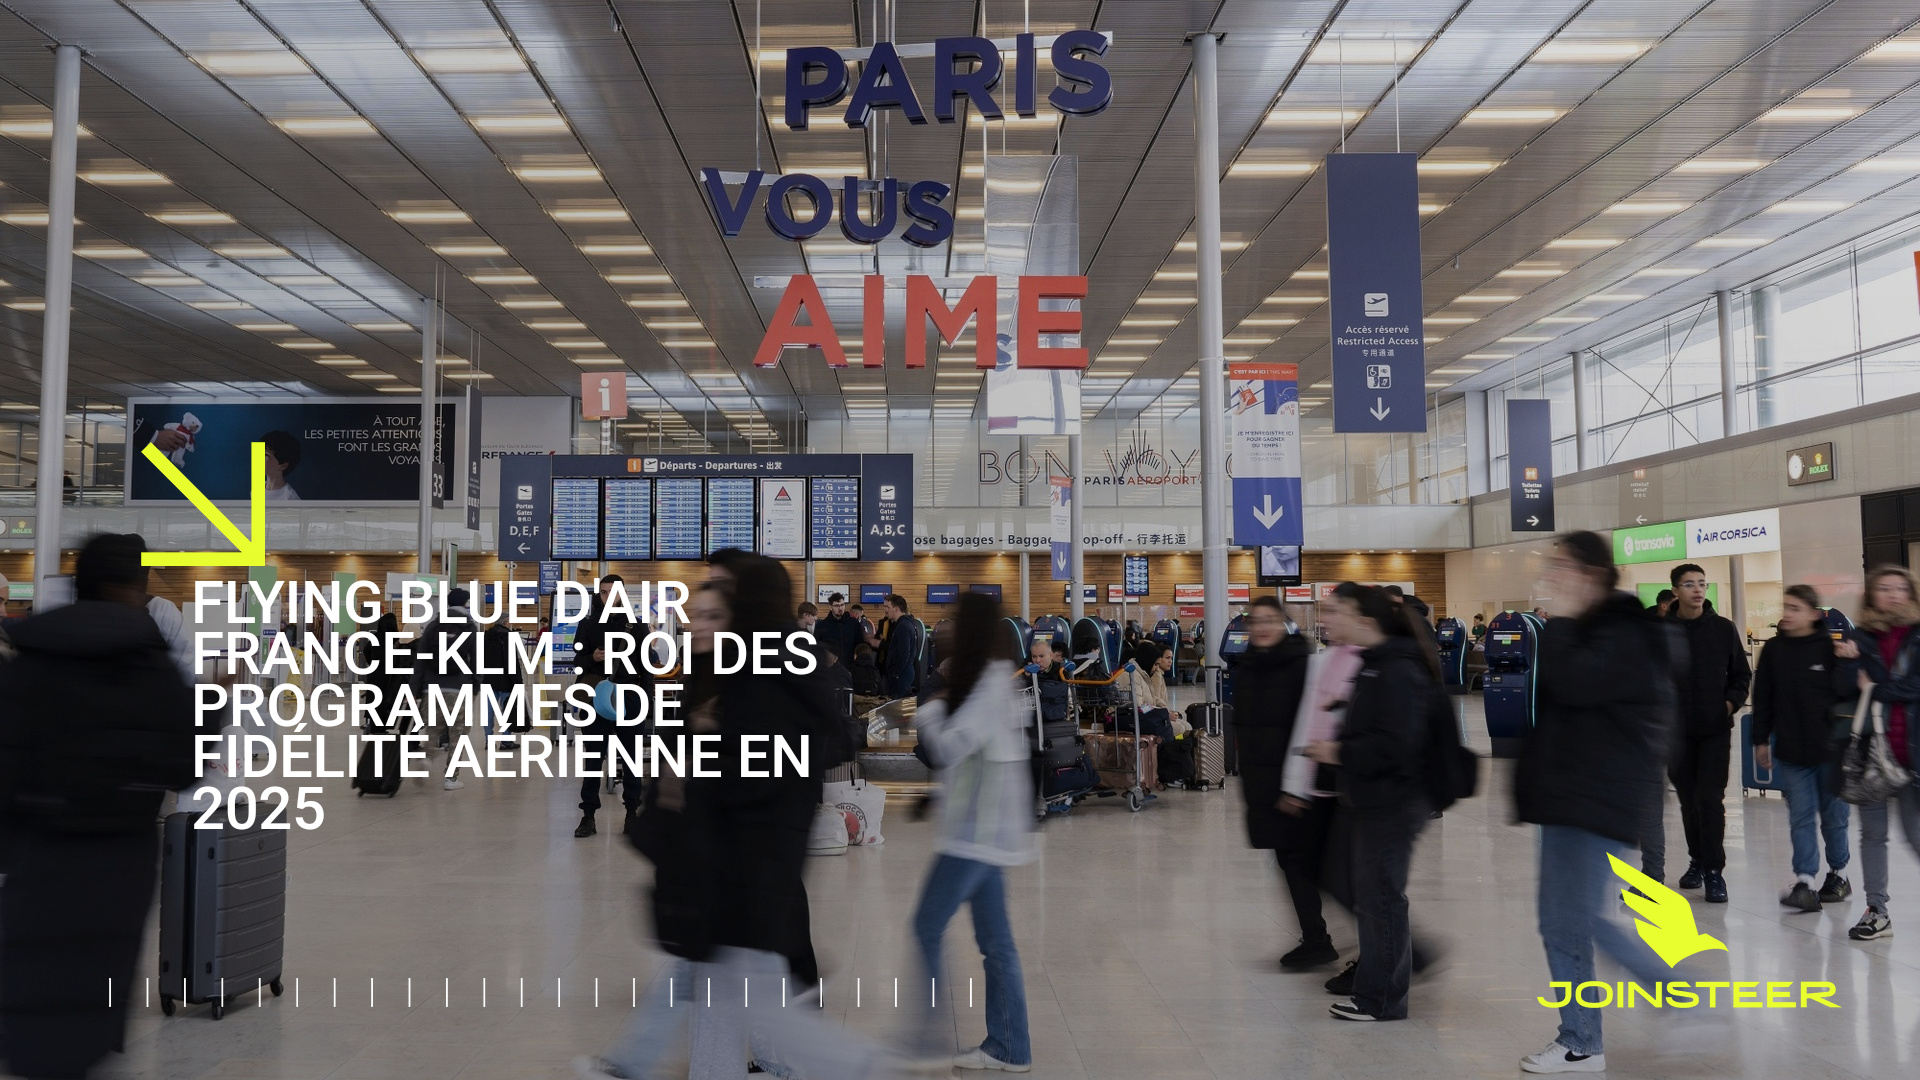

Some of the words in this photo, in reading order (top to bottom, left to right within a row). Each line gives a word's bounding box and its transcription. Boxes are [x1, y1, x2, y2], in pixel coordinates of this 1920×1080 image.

[784, 29, 1115, 131] PARIS
[701, 166, 955, 249] VOUS
[752, 274, 1090, 370] AIME
[1345, 325, 1372, 334] Accès
[1375, 325, 1410, 334] réservé
[1337, 336, 1385, 346] Restricted
[1388, 336, 1419, 346] Access
[1361, 348, 1395, 358] 专用通道
[373, 414, 383, 426] À
[386, 416, 416, 426] TOUT
[304, 430, 324, 440] LES
[326, 430, 369, 440] PETITES
[337, 443, 369, 453] FONT
[371, 443, 391, 453] LES
[659, 461, 697, 472] Départs
[705, 461, 757, 472] Departures
[766, 461, 782, 470] 出发
[979, 450, 1075, 486] BON
[1808, 464, 1829, 475] ROLEX
[432, 473, 444, 499] 33
[1084, 476, 1125, 486] PARIS
[515, 503, 534, 511] Portes
[878, 501, 897, 509] Portes
[516, 509, 533, 517] Gates
[509, 525, 540, 537] D,E,F
[869, 524, 906, 537] A,B,C
[1702, 531, 1719, 543] AIR
[1719, 526, 1767, 542] CORSICA
[914, 537, 936, 545] ose
[940, 534, 994, 547] bagages
[1082, 533, 1124, 547] op-off
[1136, 533, 1187, 545] 行李托运
[1633, 533, 1675, 552] transavia
